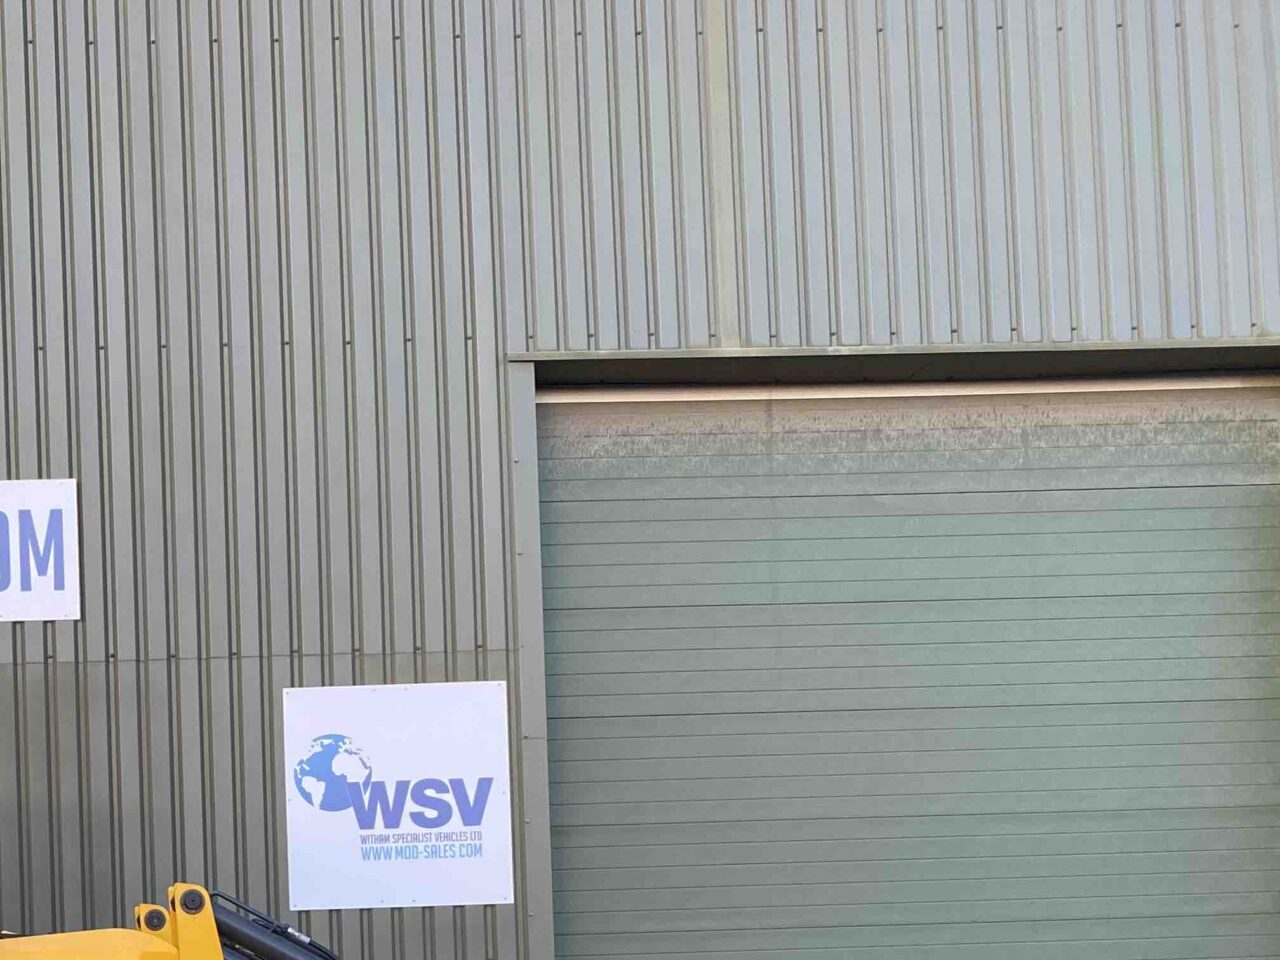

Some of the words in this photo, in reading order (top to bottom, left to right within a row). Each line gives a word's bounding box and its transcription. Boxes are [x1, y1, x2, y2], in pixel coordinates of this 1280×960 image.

[347, 777, 495, 830] WSV
[360, 834, 391, 845] WITHAM
[392, 832, 433, 844] SPECIALIST
[434, 831, 469, 843] VEHICLES
[469, 830, 483, 841] LTD
